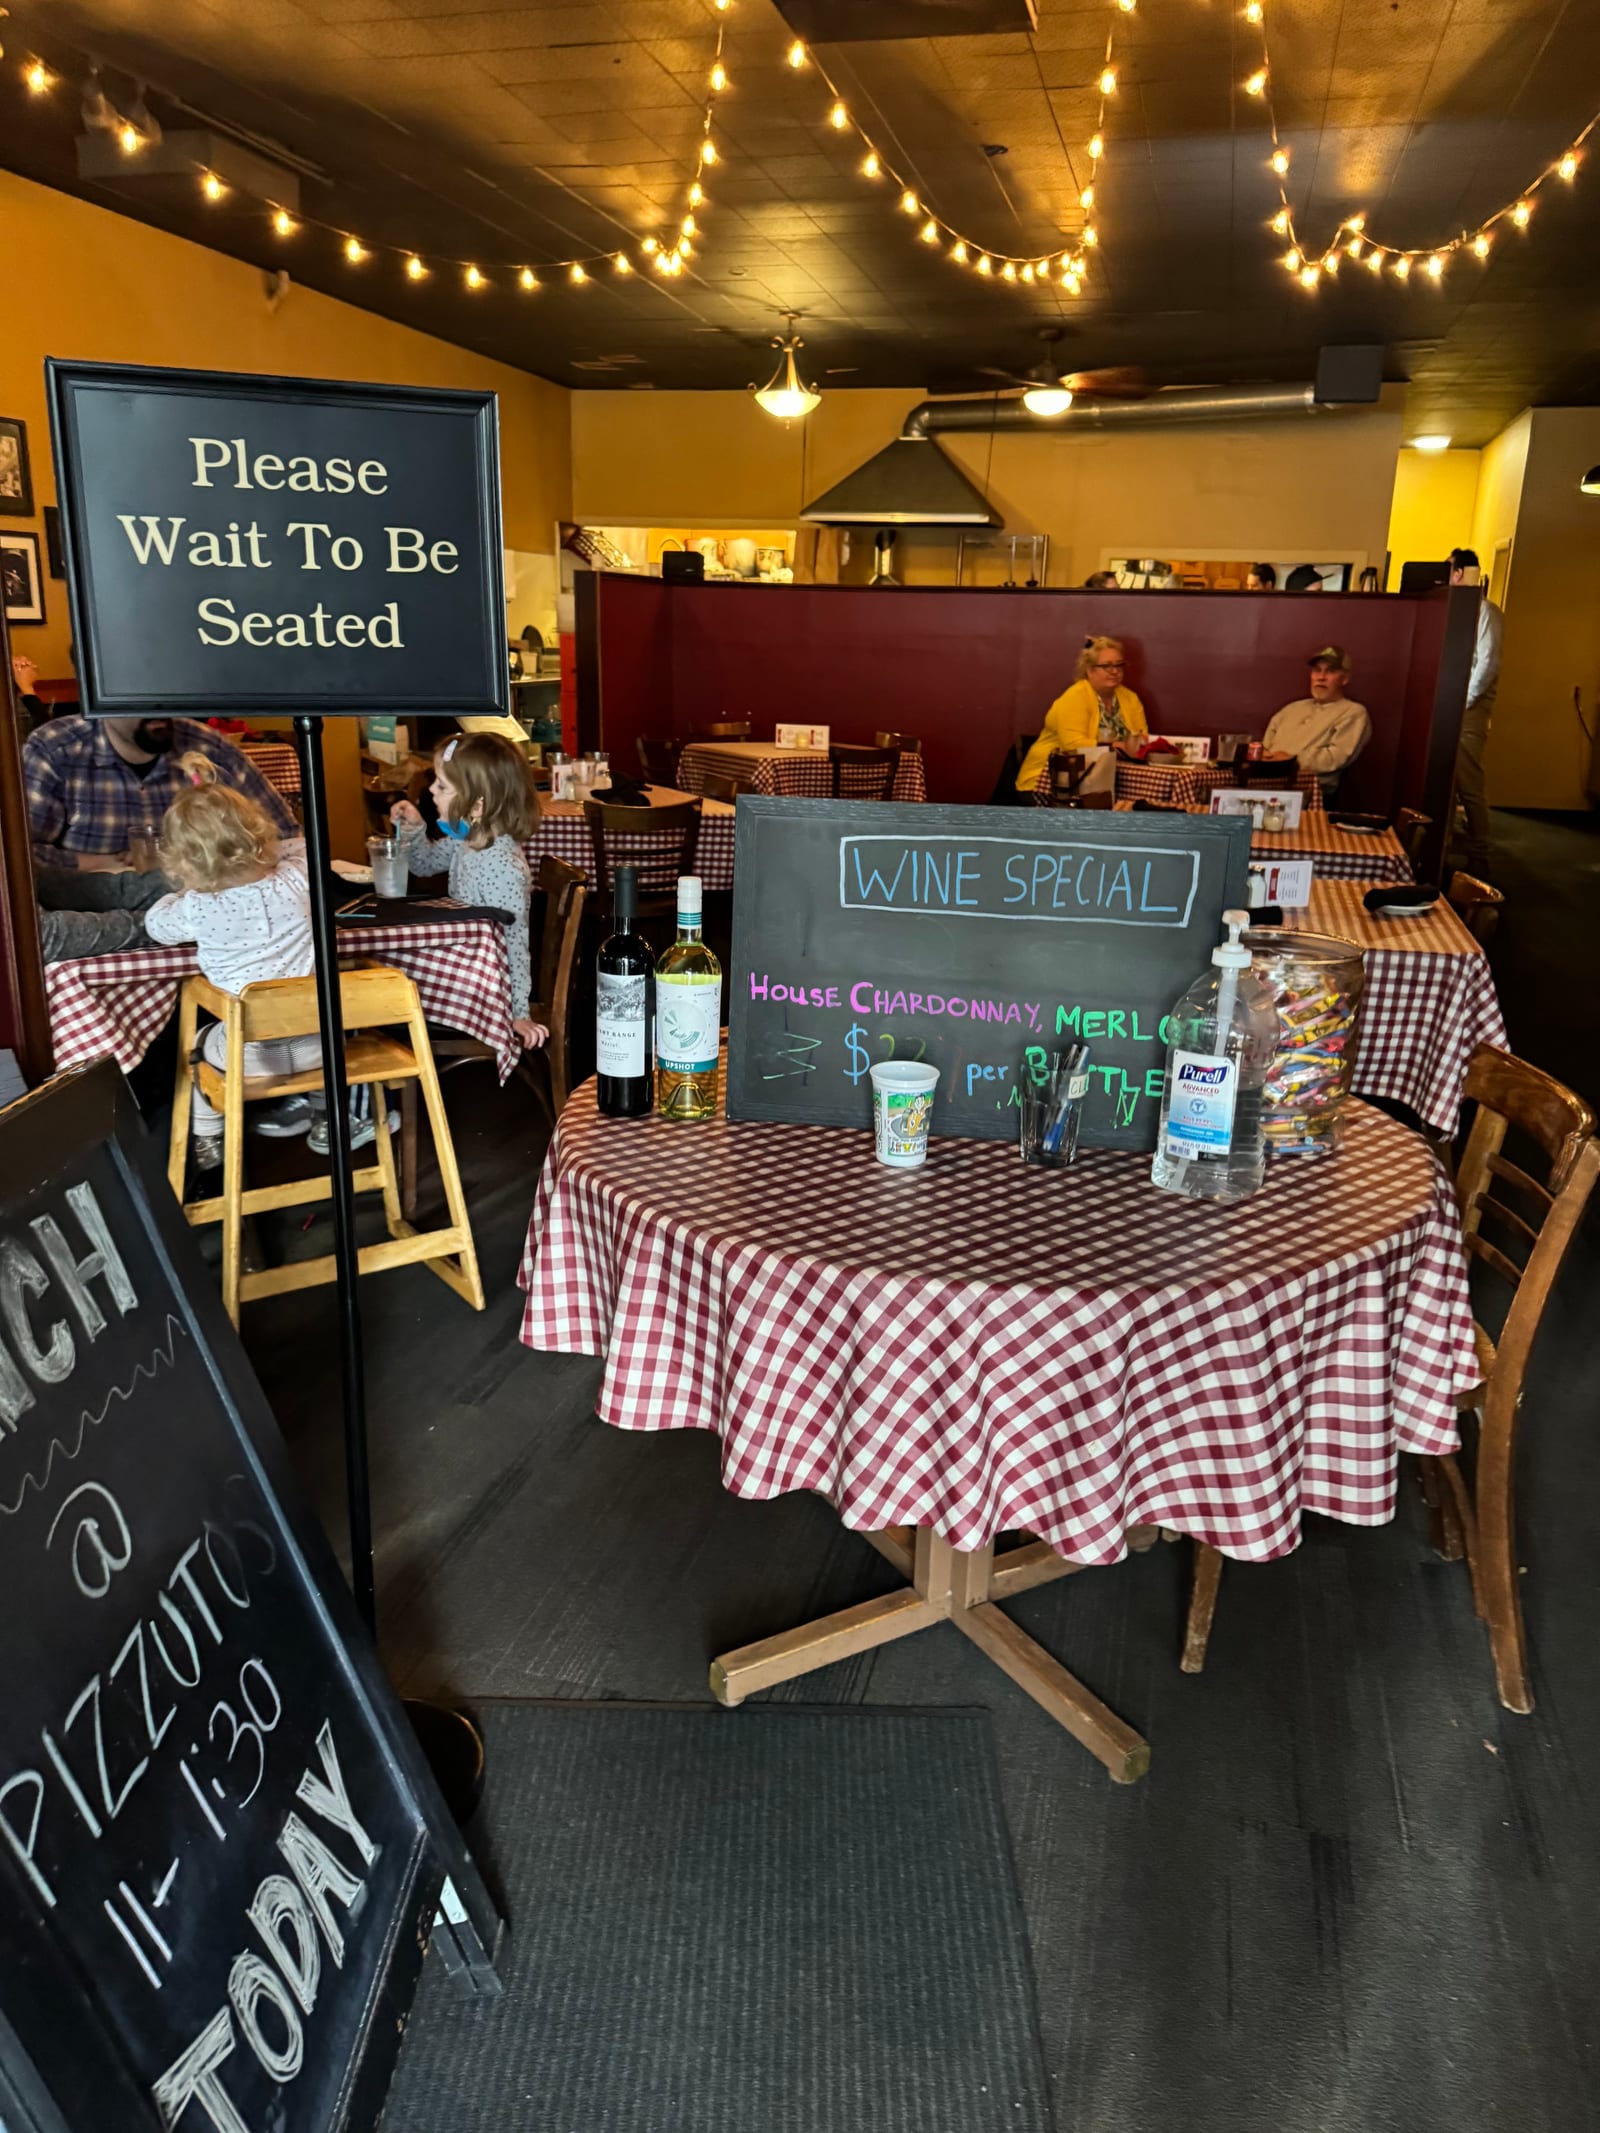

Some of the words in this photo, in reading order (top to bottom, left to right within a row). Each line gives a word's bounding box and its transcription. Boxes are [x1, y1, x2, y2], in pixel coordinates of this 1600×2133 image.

[188, 437, 389, 495] Please
[117, 515, 272, 568] Wait
[286, 523, 364, 571] To
[384, 527, 459, 574] Be
[197, 597, 405, 648] Seated
[853, 847, 981, 905] WINE
[1003, 854, 1179, 913] SPECIAL
[850, 981, 1043, 1033] CHARDONNAY,
[665, 1060, 695, 1071] UPSHOT
[966, 1062, 1009, 1096] per
[1025, 1045, 1164, 1099] BTTLE
[1182, 1083, 1219, 1095] ADVANCED
[47, 1481, 133, 1599] @
[152, 1718, 382, 2133] TODAY
